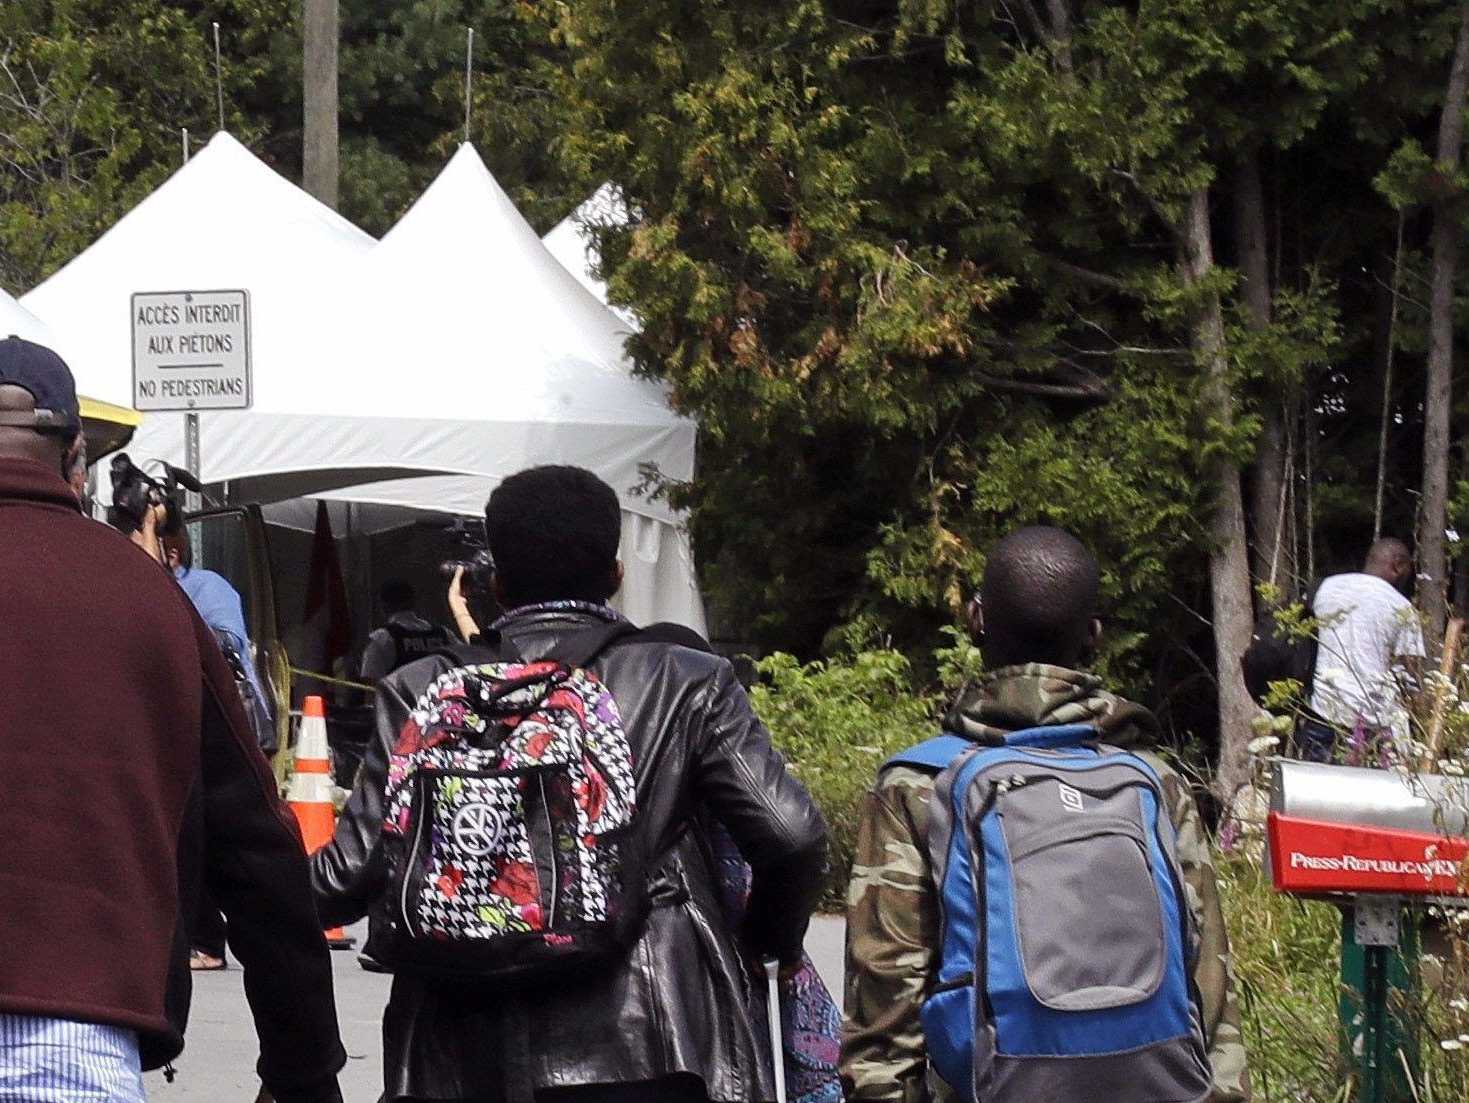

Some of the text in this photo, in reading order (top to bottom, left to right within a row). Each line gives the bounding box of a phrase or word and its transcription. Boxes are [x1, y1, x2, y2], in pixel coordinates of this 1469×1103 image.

[137, 303, 241, 325] ACCÈS INTERDIT
[148, 335, 174, 354] AUX
[139, 378, 243, 397] NO PEDESTRIANS
